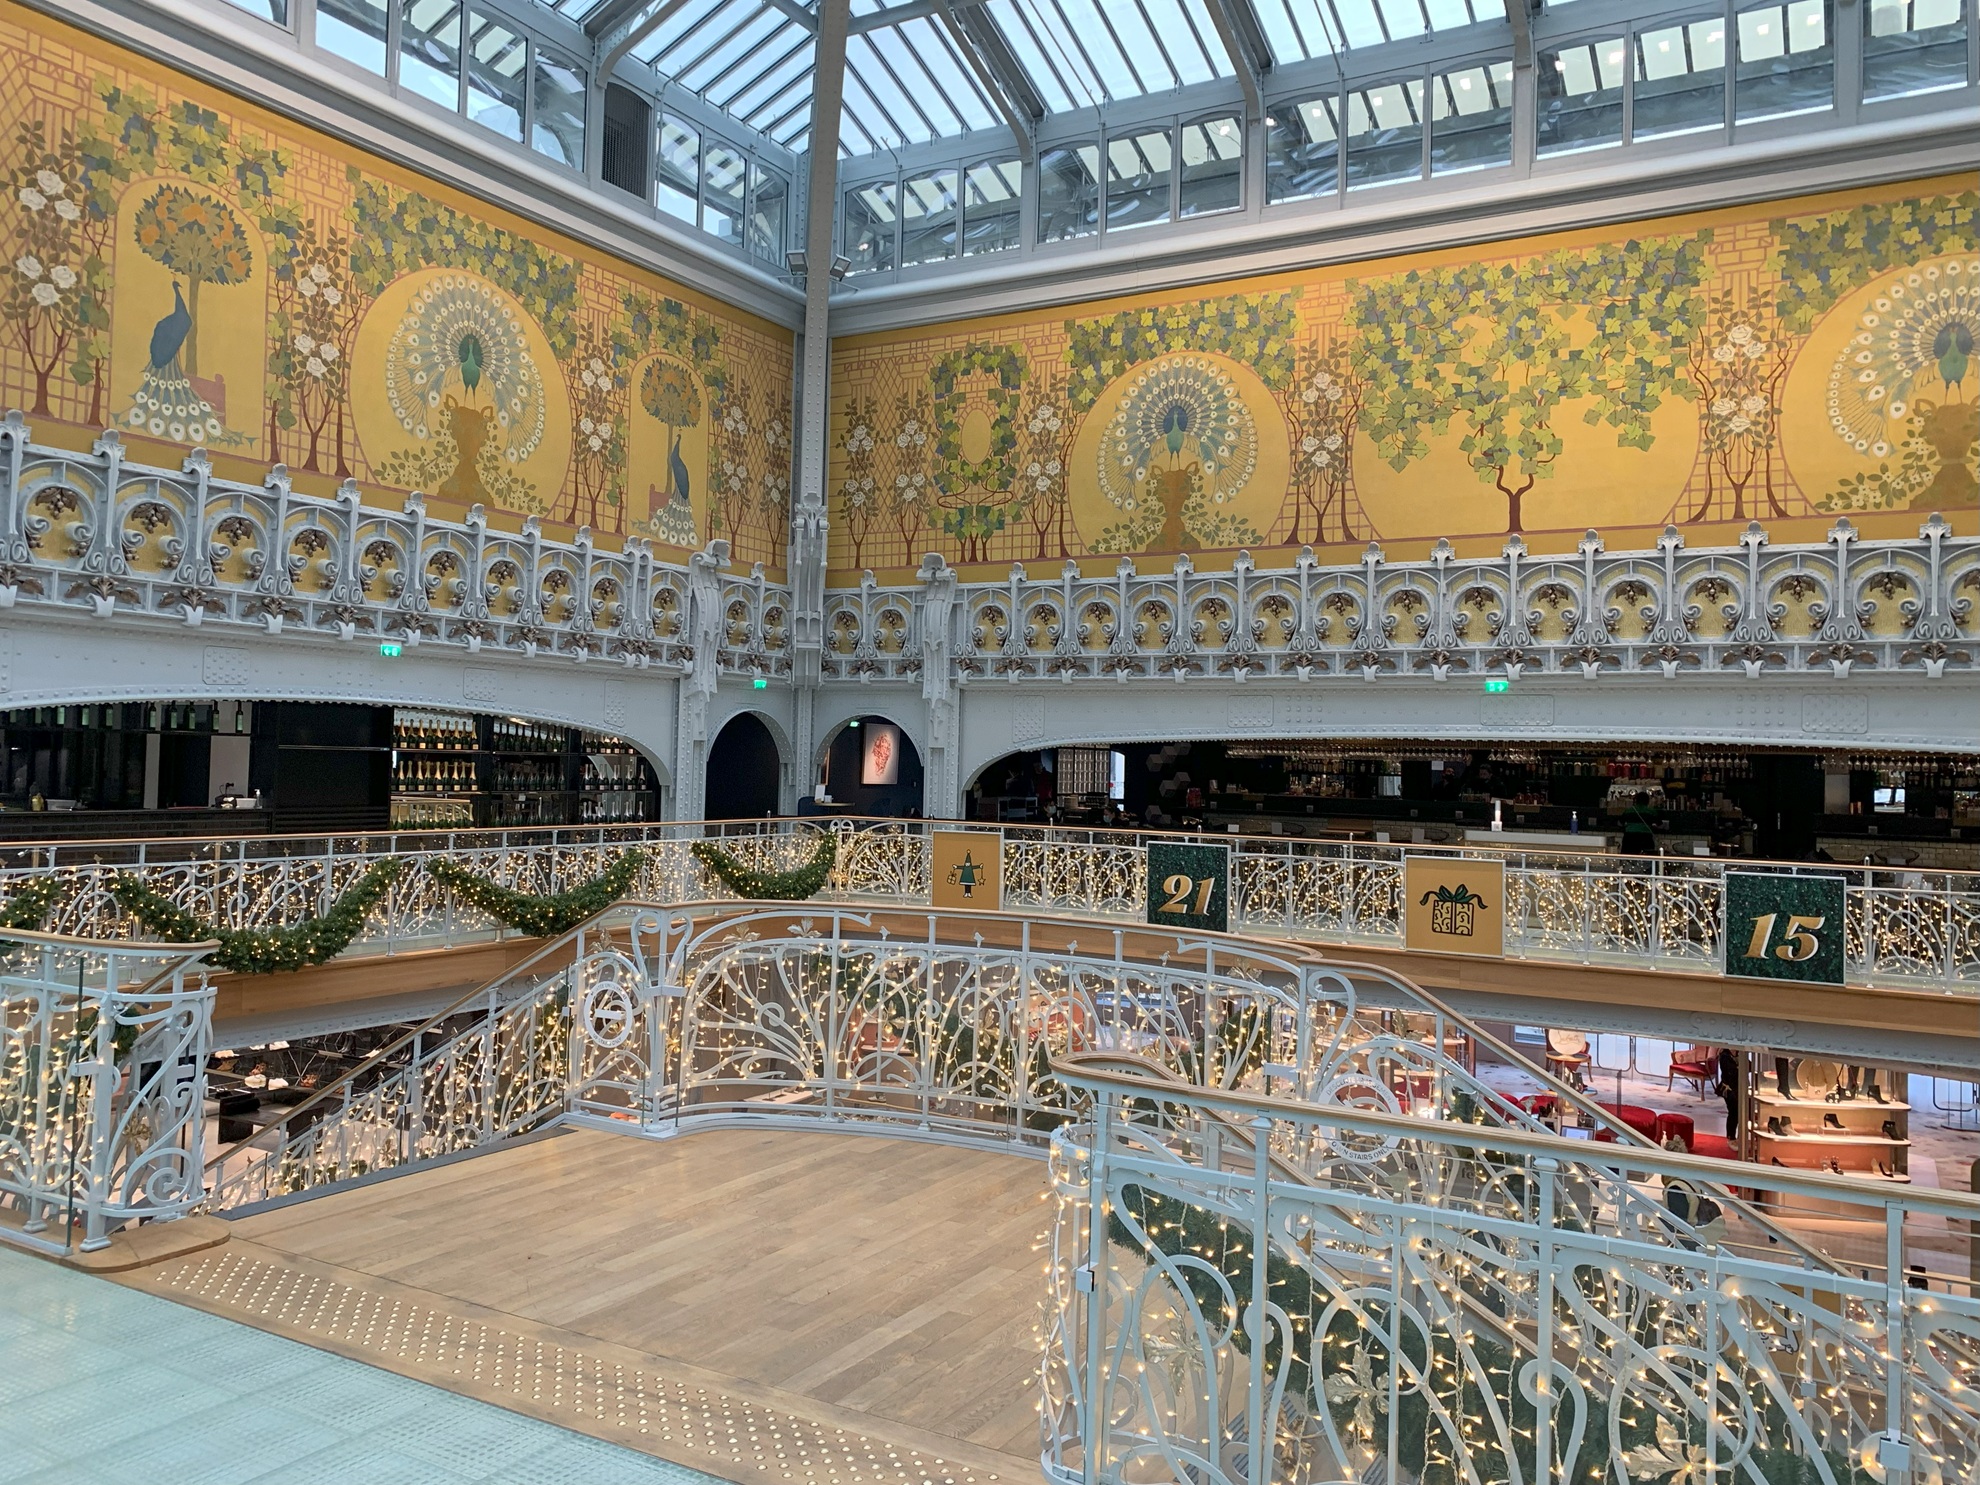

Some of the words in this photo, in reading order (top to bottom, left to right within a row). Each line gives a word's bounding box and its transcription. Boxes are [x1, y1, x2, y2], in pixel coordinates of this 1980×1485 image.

[1157, 874, 1215, 916] 21
[1742, 912, 1826, 962] 15
[1349, 1151, 1373, 1161] STAIRS
